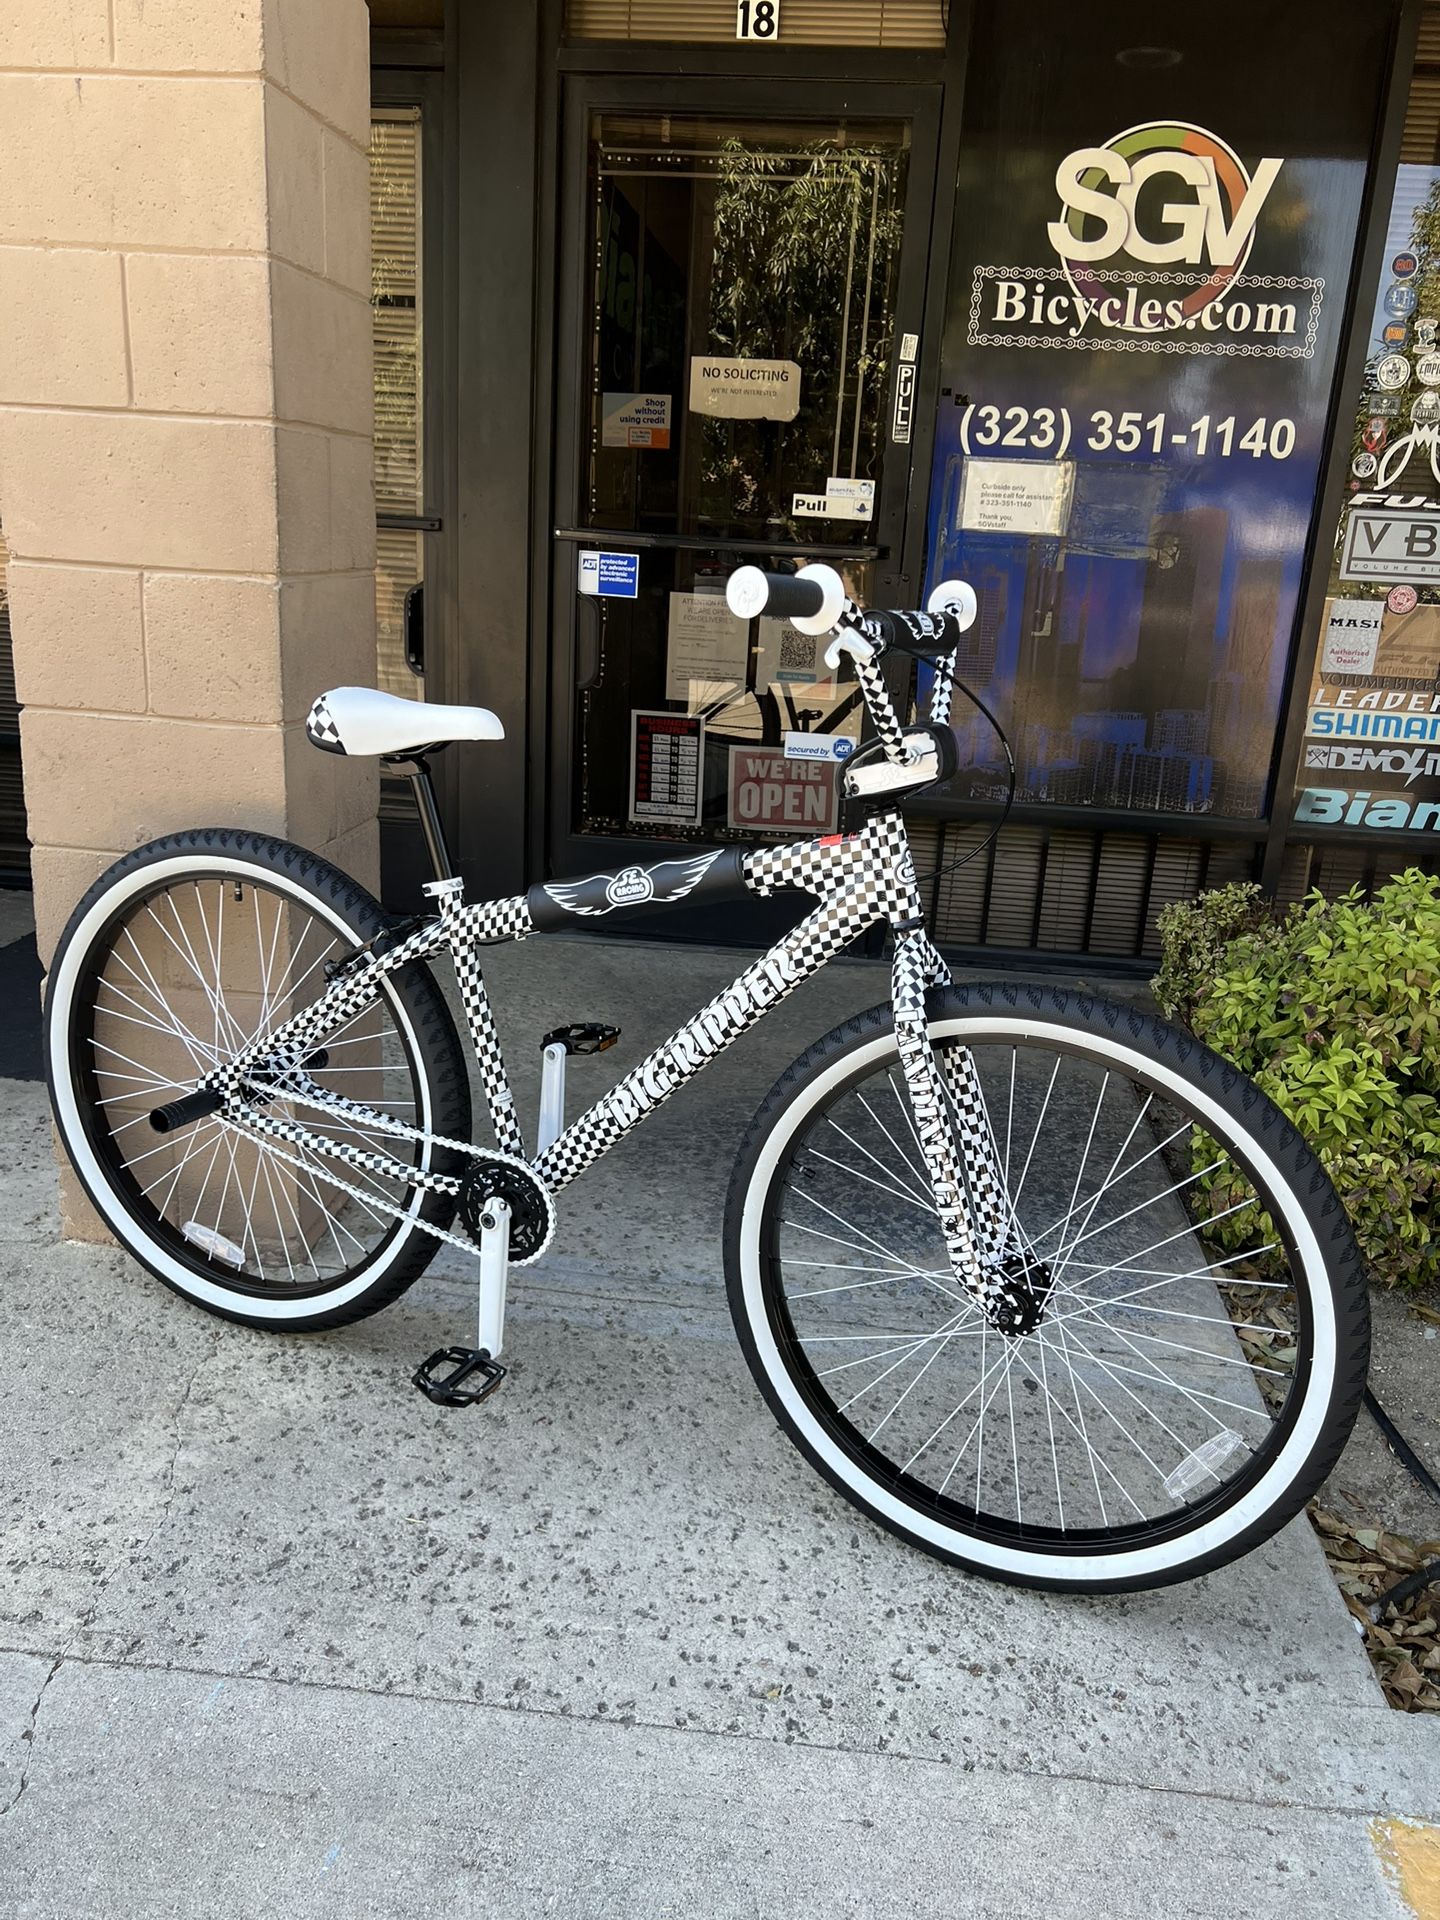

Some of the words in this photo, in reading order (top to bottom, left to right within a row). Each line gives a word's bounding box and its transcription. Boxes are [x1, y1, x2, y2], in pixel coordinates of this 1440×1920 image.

[739, 1, 775, 37] 18
[1047, 147, 1284, 266] SGV
[992, 282, 1296, 337] Bicycles.com
[702, 367, 721, 378] NO
[724, 367, 789, 382] SOLICITING
[743, 389, 777, 397] INTERESTED
[897, 367, 912, 425] PULL
[645, 398, 666, 408] Shop
[635, 407, 666, 416] without
[619, 416, 641, 425] using
[642, 416, 665, 424] credit
[960, 404, 1072, 459] (323)
[1088, 410, 1295, 459] 351-1140
[981, 483, 1011, 491] Curbside
[981, 491, 1002, 499] please
[795, 499, 827, 512] Pull
[986, 500, 1032, 508] 323-351-1140
[583, 560, 597, 569] ADT
[1353, 563, 1409, 571] VOLUME
[1329, 617, 1379, 629] MASI
[1329, 648, 1370, 657] Authorized
[1336, 656, 1361, 665] Dealer
[787, 746, 818, 754] secured
[820, 747, 830, 756] by
[746, 757, 823, 781] WE'RE
[739, 781, 826, 822] OPEN
[1294, 788, 1440, 830] Bian
[619, 869, 640, 887] SE
[616, 883, 645, 897] RACING
